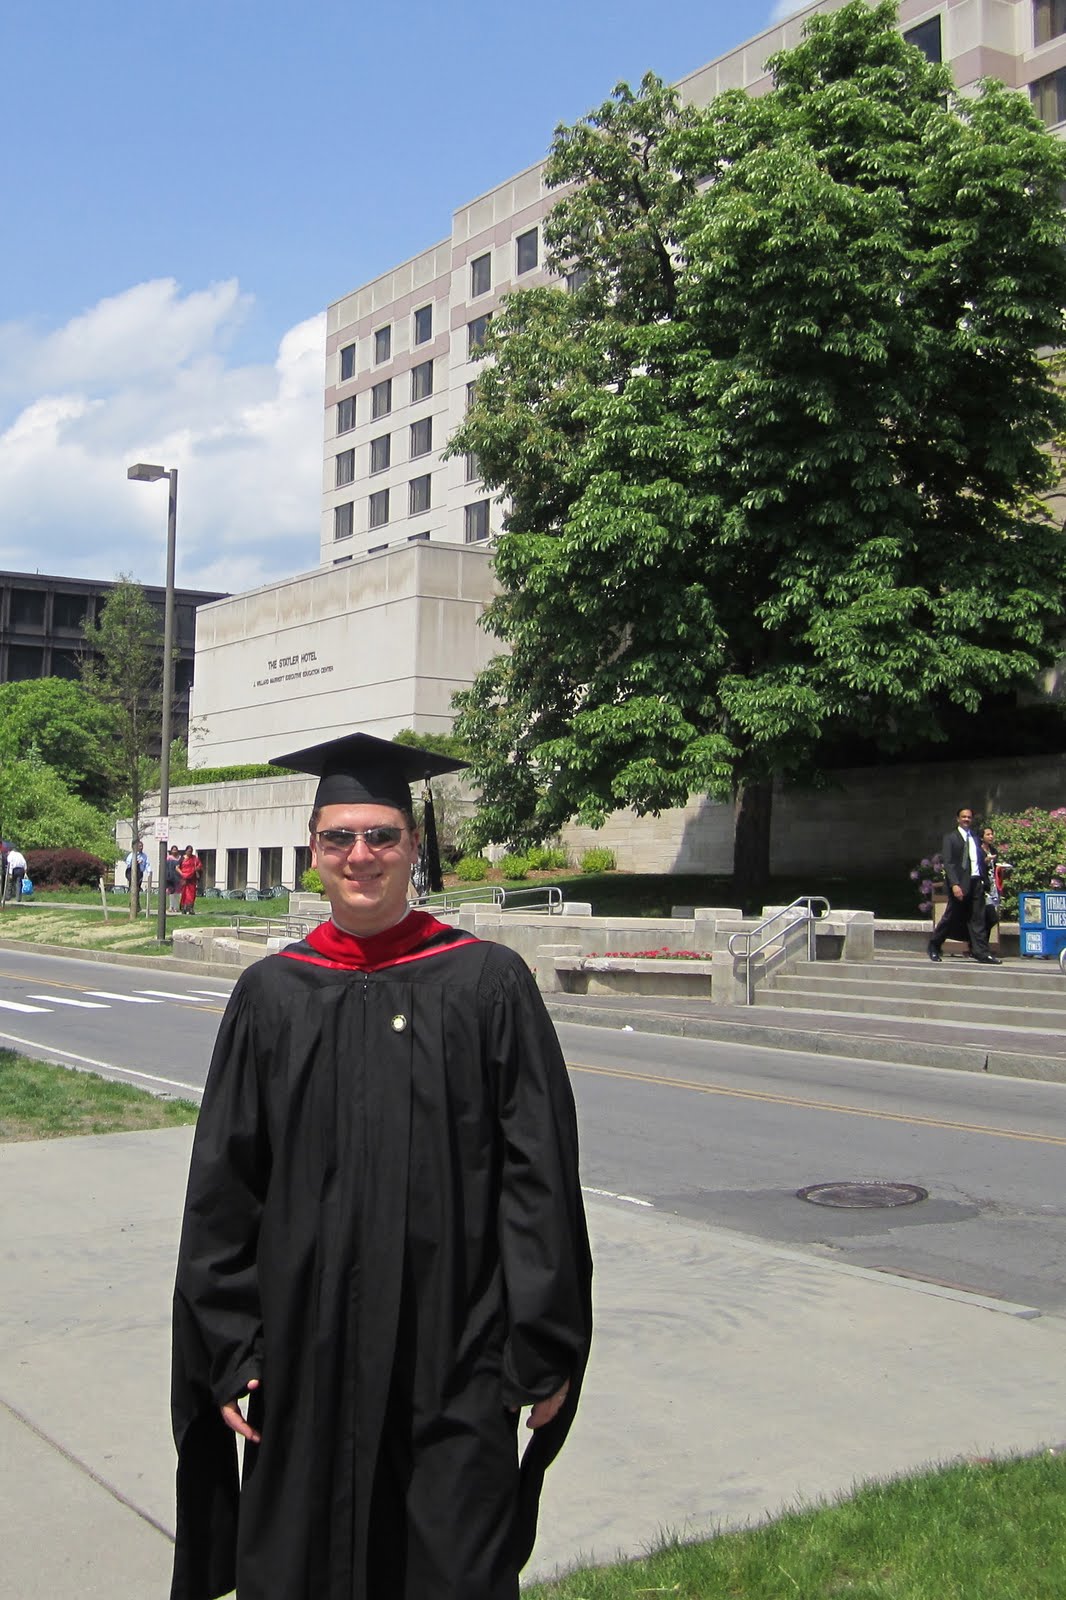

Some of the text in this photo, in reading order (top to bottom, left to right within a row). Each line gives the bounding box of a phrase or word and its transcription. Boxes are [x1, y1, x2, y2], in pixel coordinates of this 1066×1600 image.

[268, 651, 317, 670] THE STATLER HOTEL
[1047, 912, 1066, 927] TIMES
